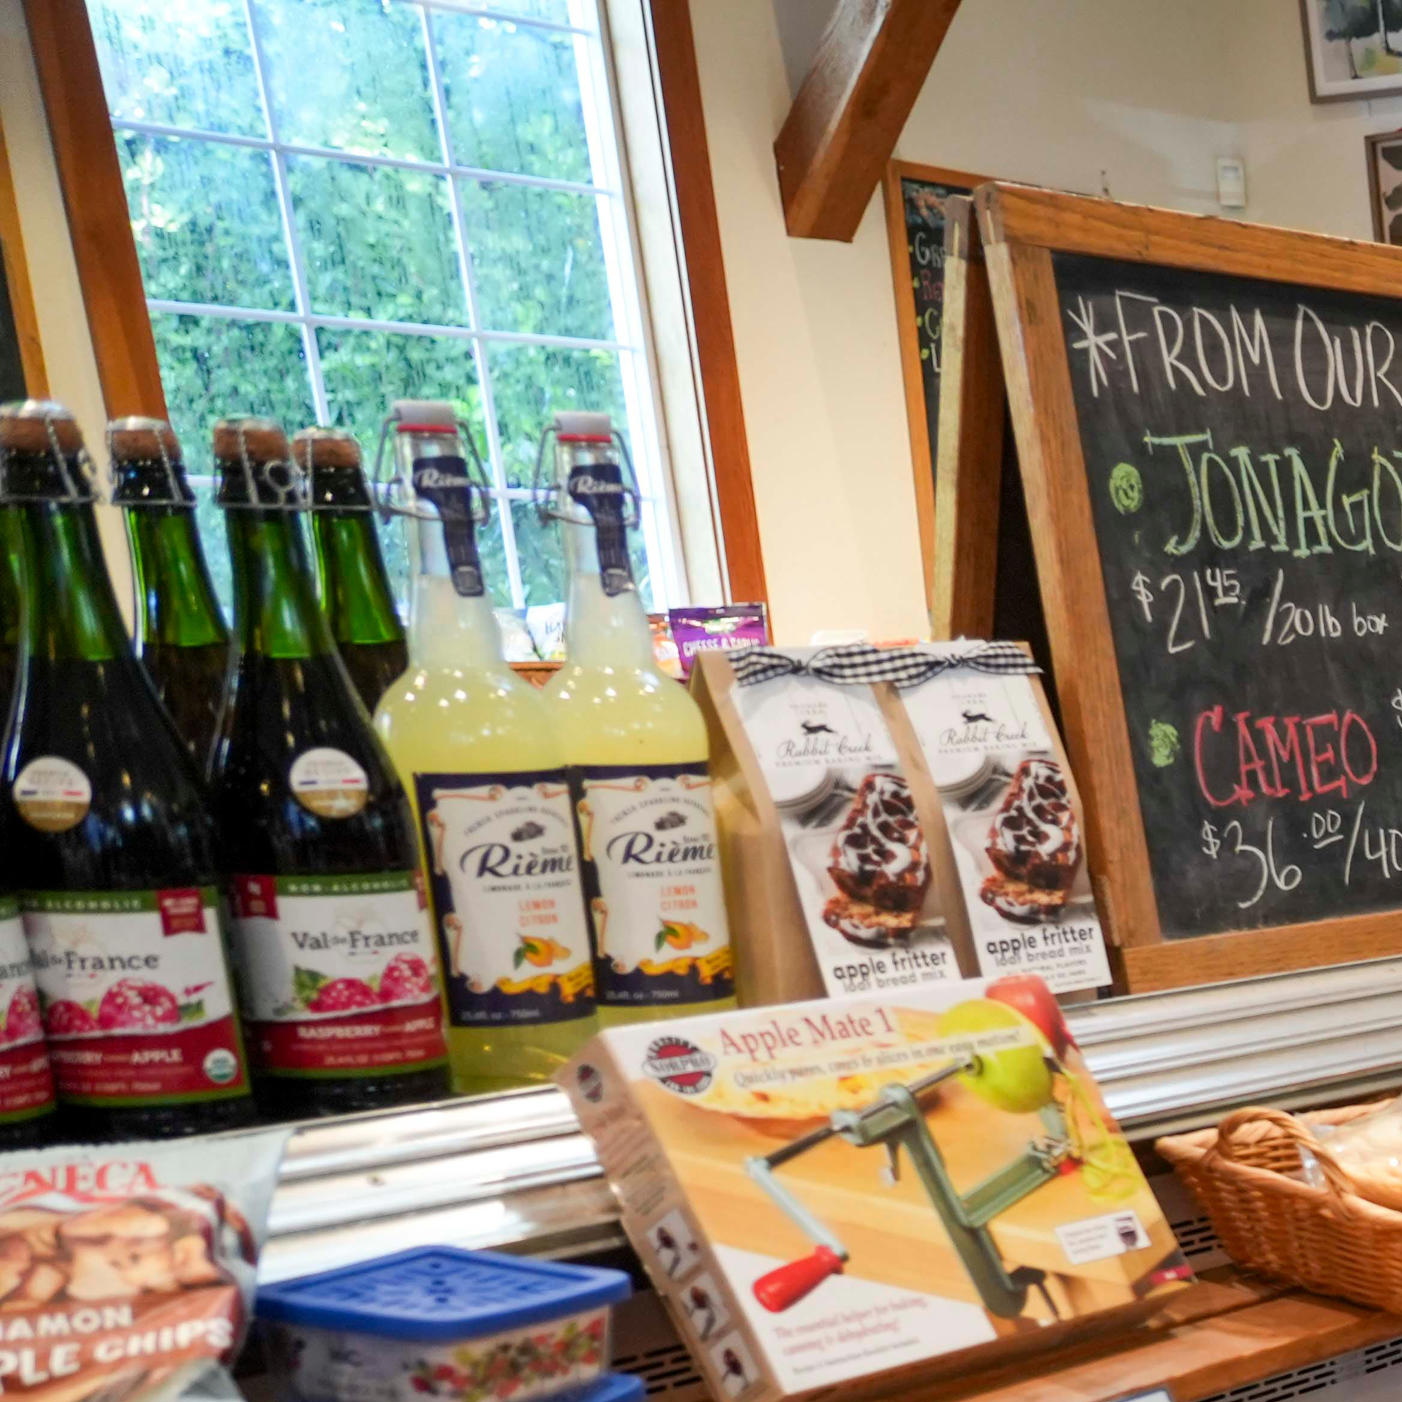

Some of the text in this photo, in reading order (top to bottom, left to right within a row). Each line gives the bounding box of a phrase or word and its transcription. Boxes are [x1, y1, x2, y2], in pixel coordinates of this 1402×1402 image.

[1295, 304, 1402, 411] OUR
[1353, 600, 1389, 635] box
[683, 639, 719, 657] CHEESE
[938, 723, 1031, 748] Rabbit Creek
[776, 736, 872, 760] Rabbit Creek
[1194, 705, 1378, 807] CAMEO
[660, 885, 696, 896] LEMON
[519, 899, 556, 912] LEMON
[292, 932, 329, 949] Val
[349, 929, 419, 948] France
[986, 925, 1094, 957] apple fritter
[64, 951, 160, 972] France
[1028, 947, 1065, 964] bread
[1069, 942, 1093, 957] mix
[833, 949, 948, 981] apple fritter
[876, 972, 915, 991] bread
[921, 968, 945, 983] mix
[719, 1007, 895, 1063] Apple Mate 1
[132, 1048, 184, 1064] APPLE
[734, 1066, 789, 1087] Quickly
[0, 1317, 233, 1386] PLE CHIPS
